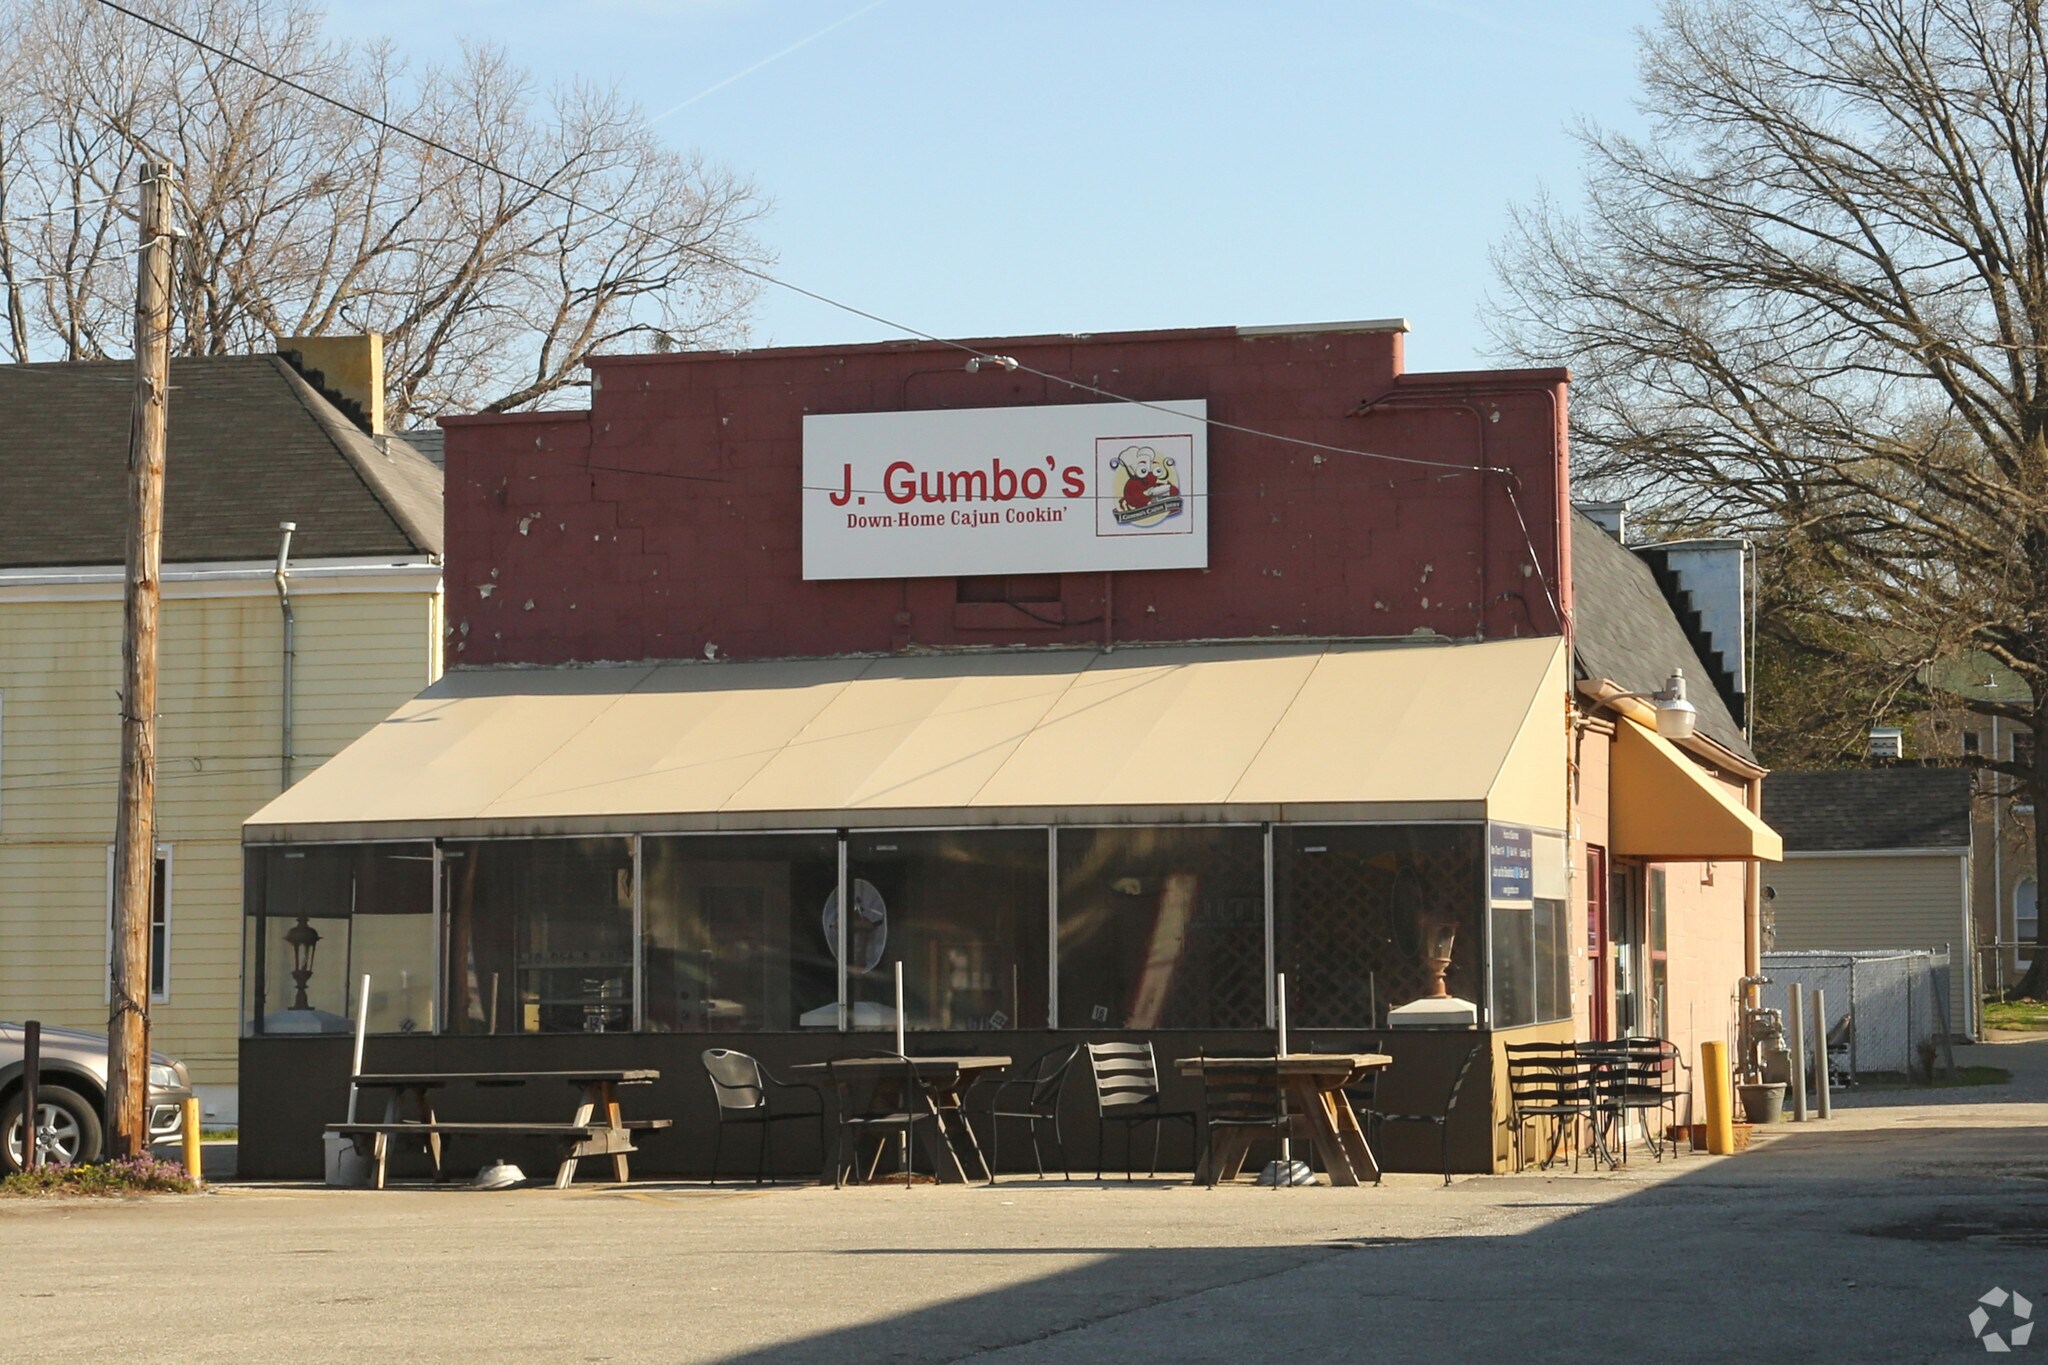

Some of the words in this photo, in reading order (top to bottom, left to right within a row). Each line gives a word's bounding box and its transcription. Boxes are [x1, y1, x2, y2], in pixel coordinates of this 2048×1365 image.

[830, 463, 866, 507] J.
[883, 455, 1086, 505] Gumbo's
[847, 511, 945, 529] Down-Home
[950, 508, 1000, 528] Cajun
[1005, 505, 1068, 524] Cookin'
